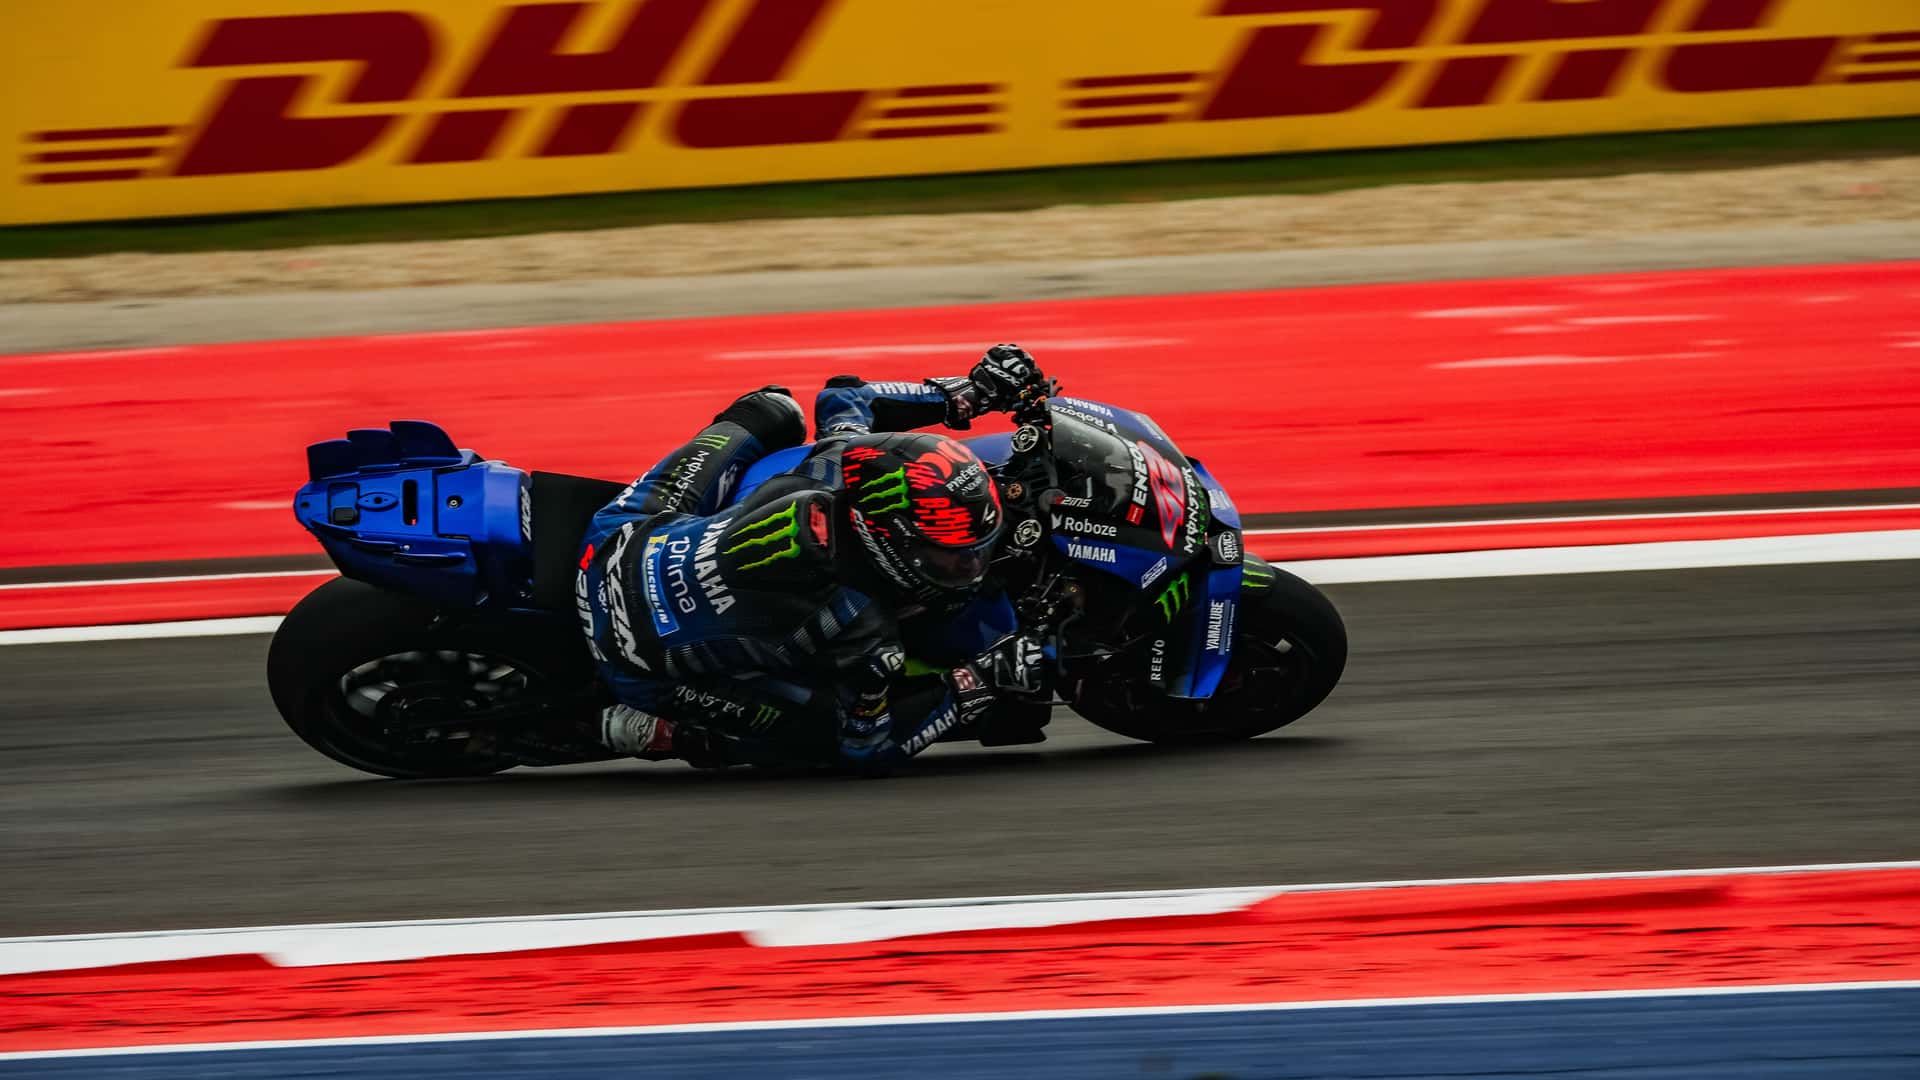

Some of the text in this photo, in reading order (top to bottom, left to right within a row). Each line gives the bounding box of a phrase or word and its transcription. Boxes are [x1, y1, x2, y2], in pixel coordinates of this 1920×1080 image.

[1199, 0, 1852, 122] DHL
[170, 0, 868, 177] DHL
[1052, 404, 1105, 427] Roboze
[1064, 396, 1114, 417] YAMAHA
[1064, 517, 1117, 537] Roboze
[1223, 533, 1234, 560] BMC
[666, 536, 697, 614] prima
[694, 517, 736, 615] YAMAHA
[1067, 543, 1116, 563] YAMAHA
[646, 558, 669, 624] MICHELIN
[1205, 600, 1225, 651] YAMALUBE
[1151, 639, 1165, 681] REEVO
